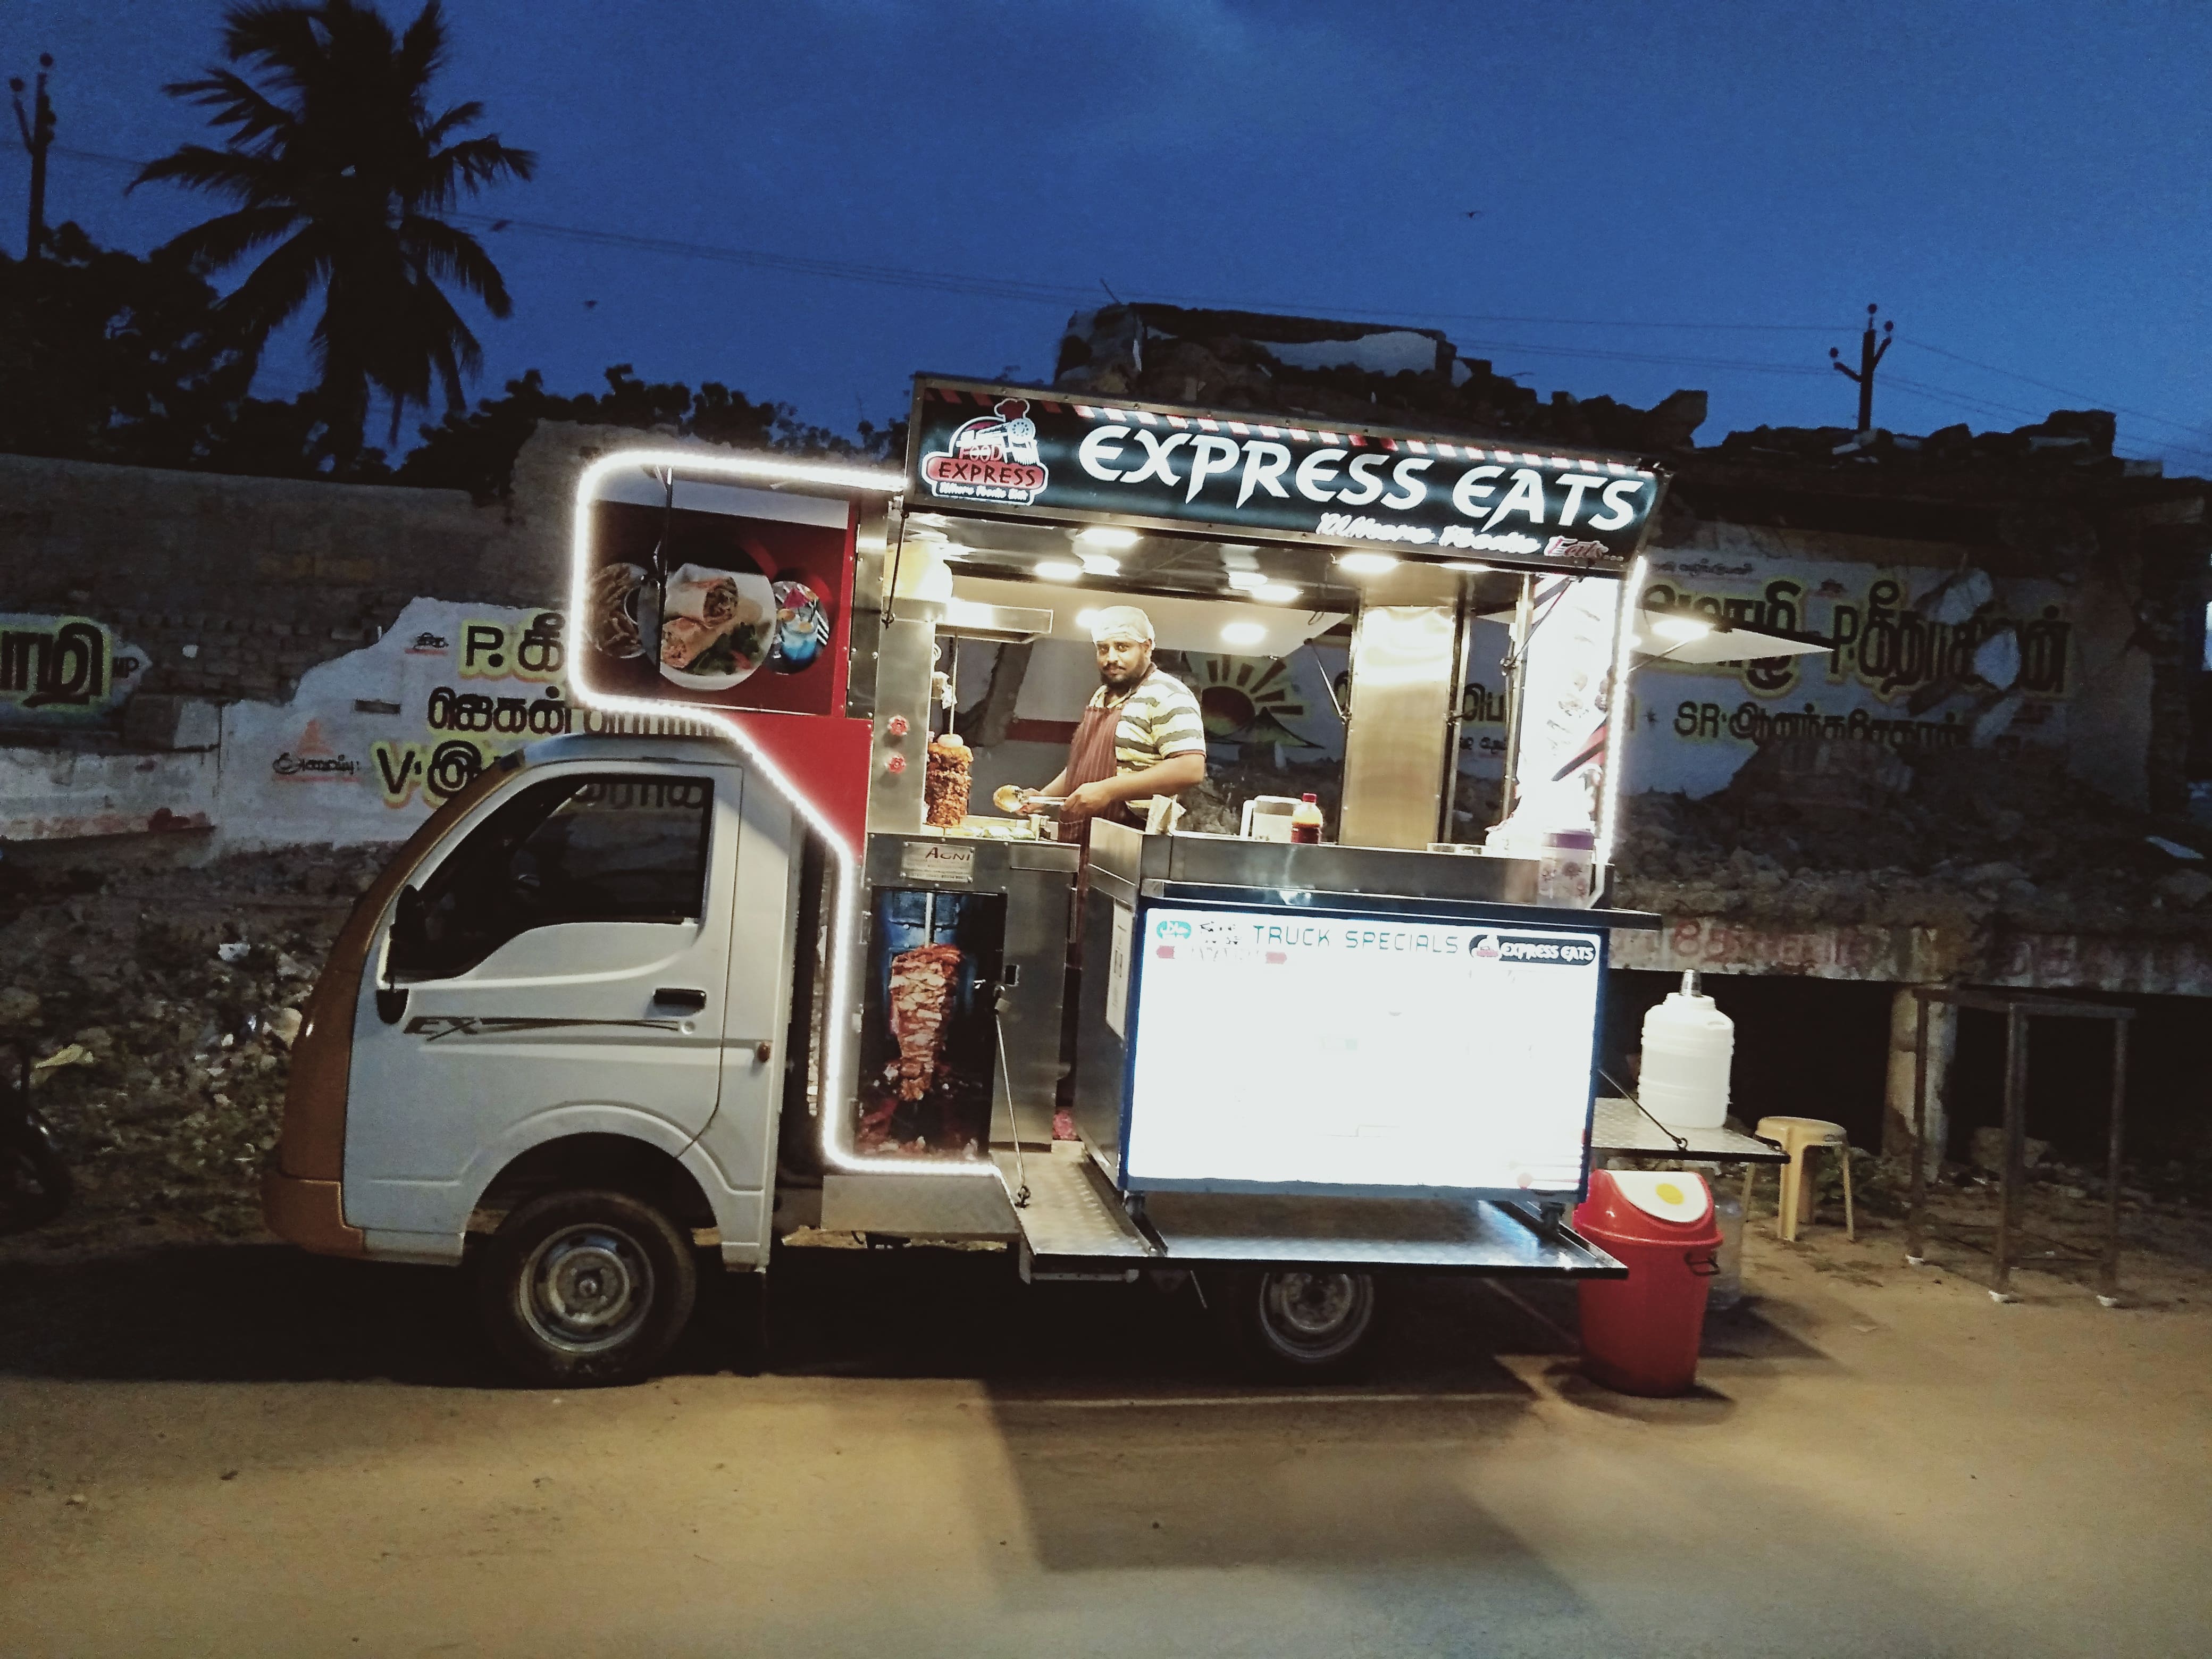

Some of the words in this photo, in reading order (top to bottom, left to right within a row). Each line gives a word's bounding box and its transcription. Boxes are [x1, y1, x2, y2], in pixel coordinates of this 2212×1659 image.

[959, 445, 1003, 463] FOOD
[939, 461, 1036, 487] EXPRESS
[1079, 425, 1435, 510] EXPRESS
[1452, 465, 1644, 532] EATS
[1253, 925, 1330, 948] TRUCK
[1346, 929, 1459, 954] SPECIALS
[1500, 942, 1560, 960] EXPRESS
[1560, 945, 1594, 962] EATS
